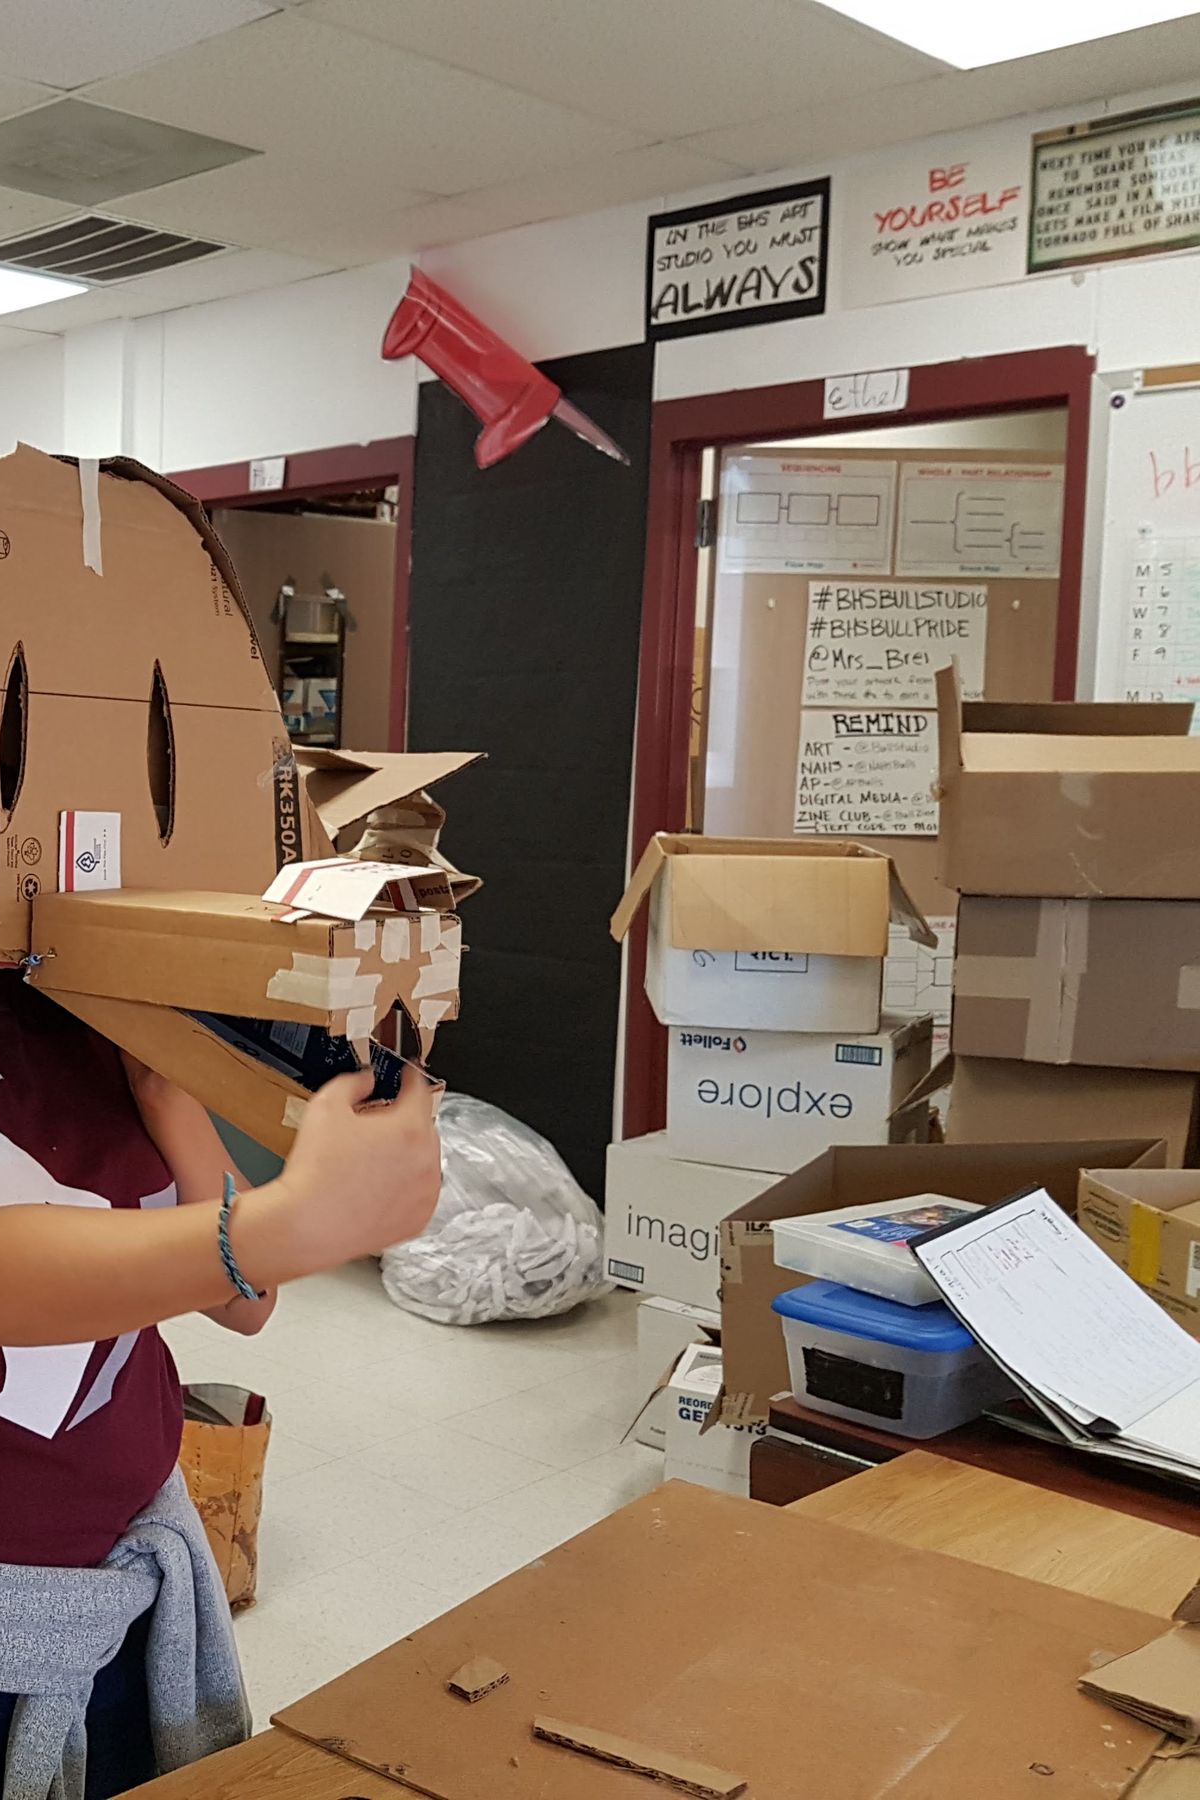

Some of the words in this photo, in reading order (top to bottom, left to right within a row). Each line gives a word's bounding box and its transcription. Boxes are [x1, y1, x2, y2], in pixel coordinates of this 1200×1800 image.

[1040, 154, 1074, 171] NEXT
[1081, 147, 1112, 164] TIME
[1063, 170, 1079, 182] TO
[1093, 158, 1134, 177] SHARE
[928, 161, 971, 193] BE
[1049, 178, 1120, 199] REMEMBER
[1131, 164, 1195, 186] SOMEONE
[873, 185, 1022, 234] YOURSELF
[1036, 202, 1071, 218] ONCE
[1087, 194, 1118, 210] SAID
[1126, 189, 1140, 203] IN
[1075, 210, 1110, 227] MAKE
[1118, 208, 1125, 219] A
[1132, 200, 1164, 217] FILM
[665, 227, 689, 246] IN
[698, 219, 728, 240] THE
[737, 210, 771, 232] BHS
[779, 200, 815, 223] ART
[1036, 229, 1098, 249] TORNADO
[1104, 222, 1135, 240] FULL
[1143, 216, 1161, 231] OF
[656, 247, 713, 272] STUDIO
[723, 239, 758, 259] YOU
[769, 225, 821, 249] MUST
[894, 251, 924, 267] YOU
[932, 240, 992, 261] SPECIAL
[651, 255, 818, 320] ALWAYS
[781, 464, 842, 474] SEQUENCING
[1135, 564, 1150, 578] M
[1160, 563, 1173, 577] 5
[812, 585, 987, 611] #BHSBULLSTUDIO
[1137, 585, 1146, 598] T
[1133, 606, 1148, 619] W
[1157, 605, 1168, 617] 7
[809, 616, 969, 639] #BHSBULLPRIDE
[1133, 627, 1142, 640] R
[1132, 648, 1140, 661] F
[1154, 647, 1167, 660] 9
[1126, 690, 1140, 701] M
[832, 713, 928, 735] REMIND
[804, 742, 834, 757] ART
[800, 793, 853, 807] DIGITAL
[277, 764, 298, 866] RK350A
[797, 811, 831, 823] ZINE
[840, 811, 871, 823] CLUB
[893, 823, 906, 832] TO
[680, 1032, 731, 1051] Follett
[697, 1079, 853, 1119] explore
[627, 1205, 720, 1261] imagi
[678, 1395, 714, 1409] REORD
